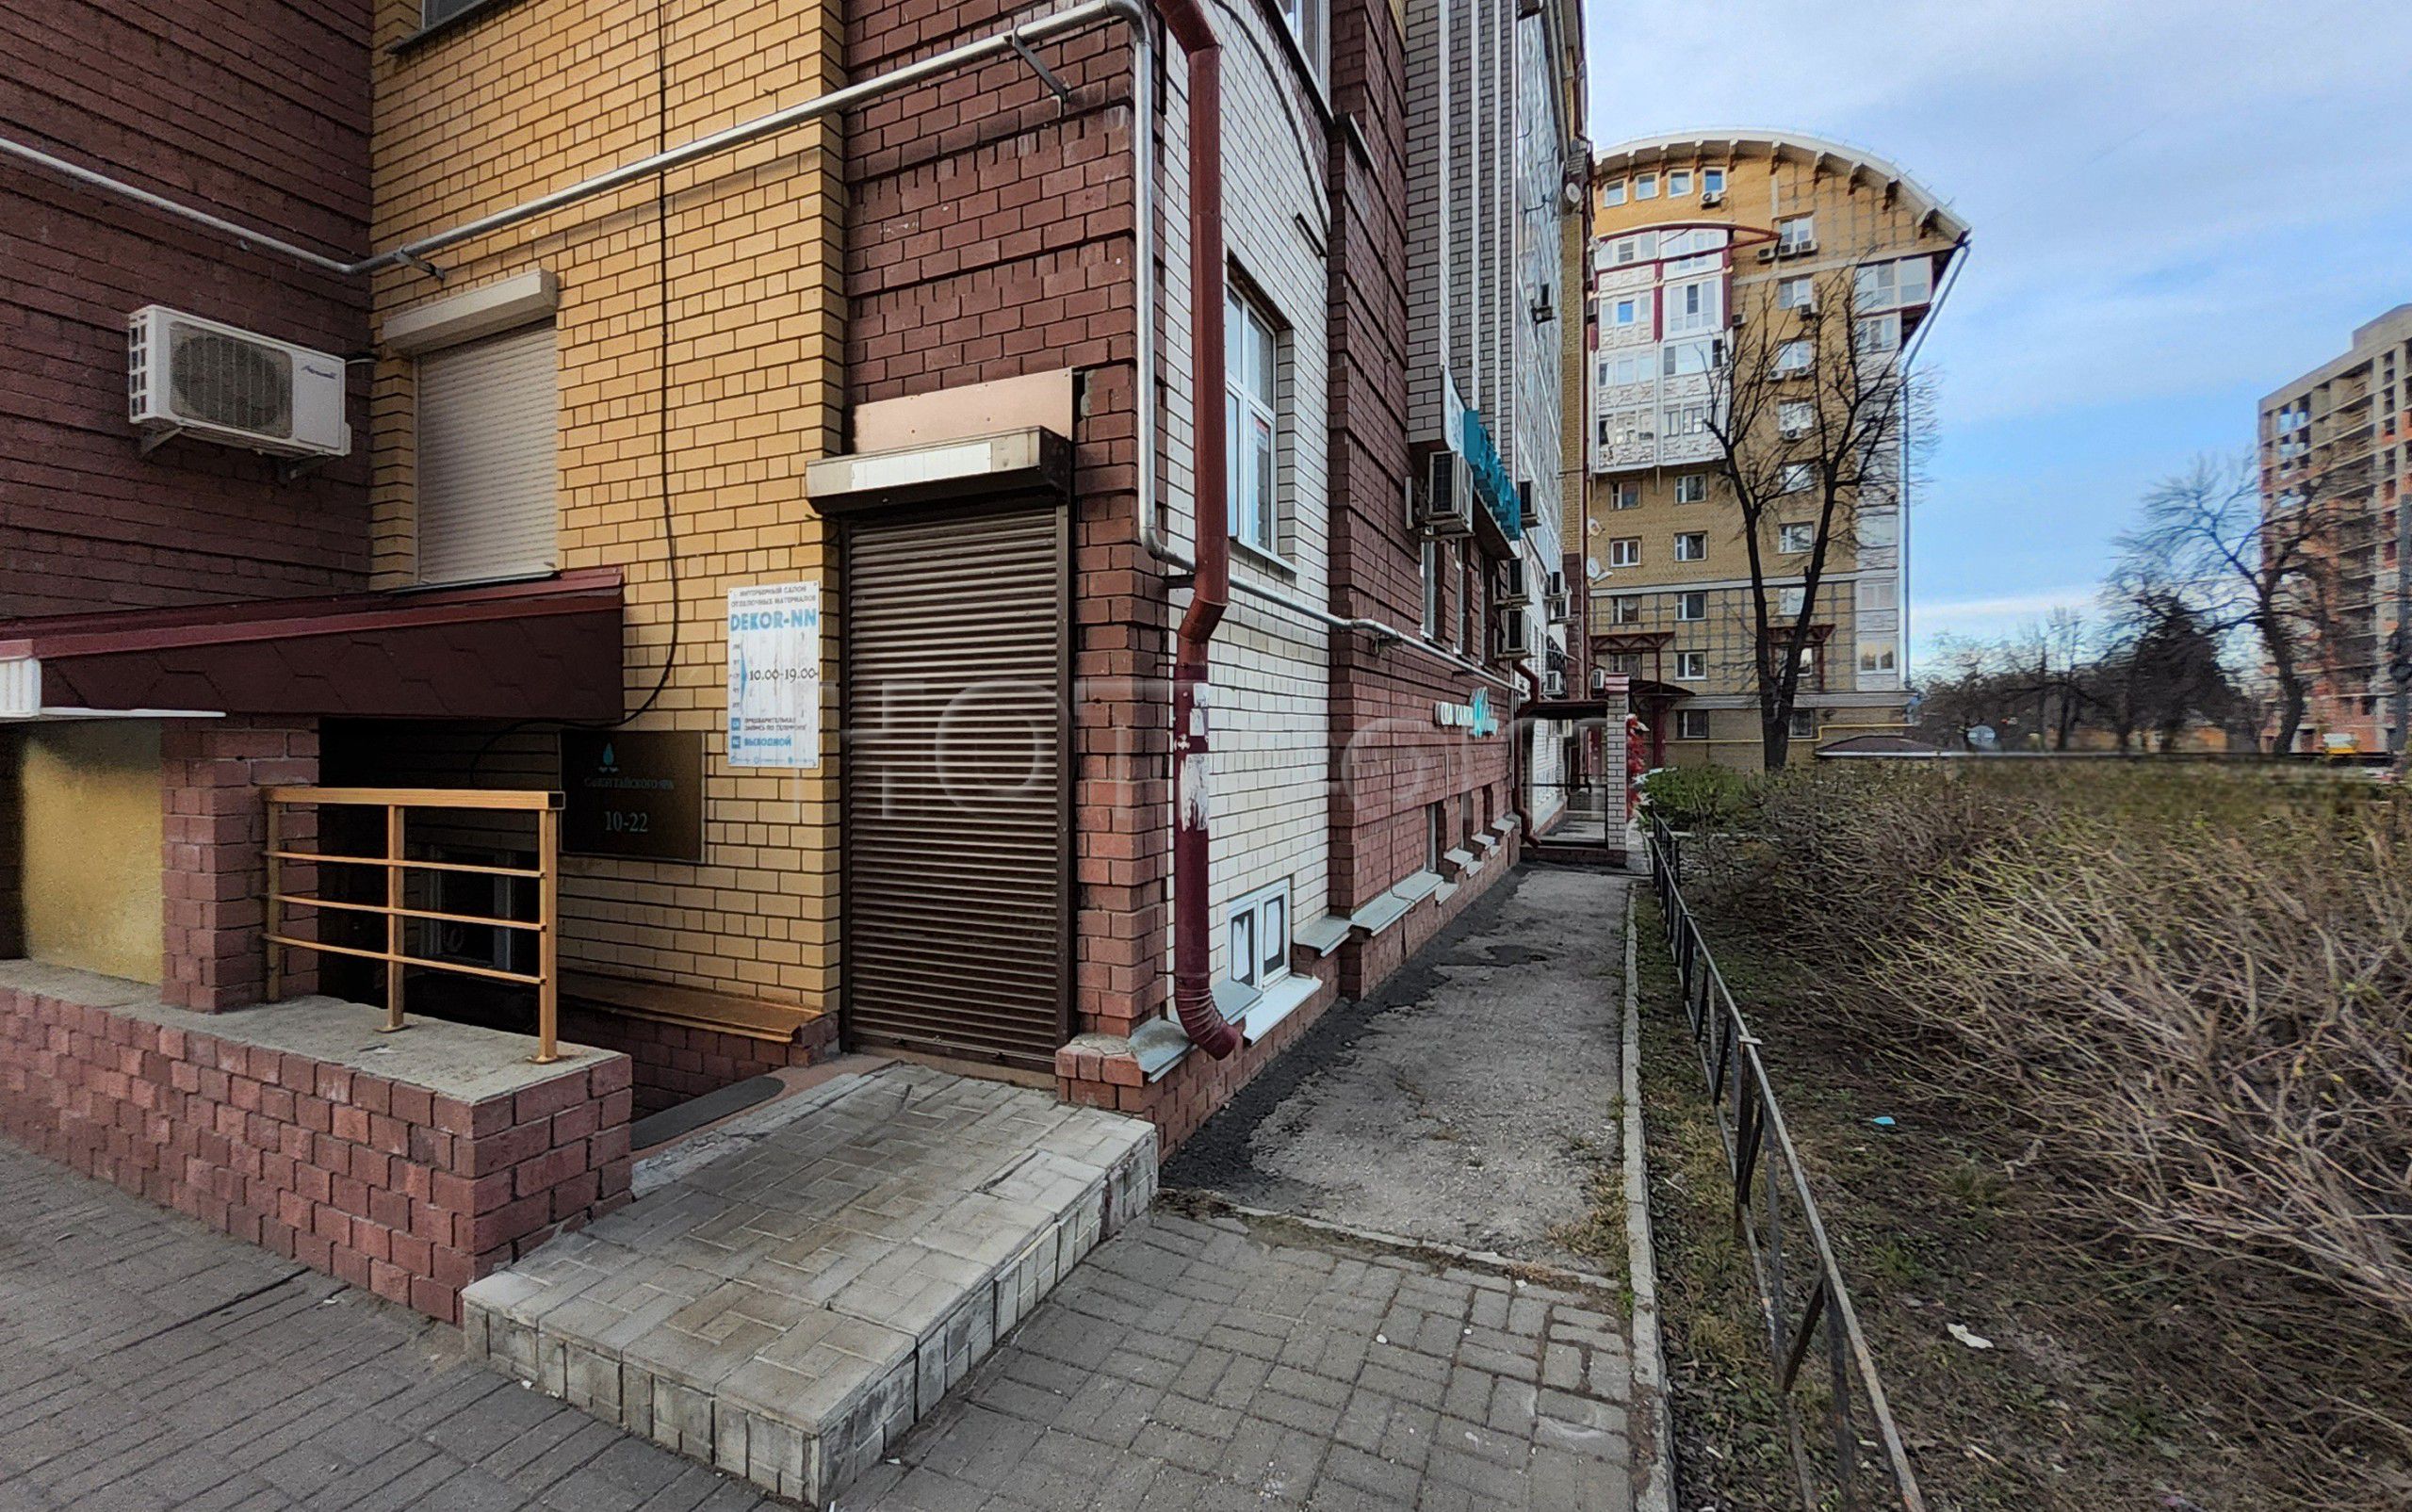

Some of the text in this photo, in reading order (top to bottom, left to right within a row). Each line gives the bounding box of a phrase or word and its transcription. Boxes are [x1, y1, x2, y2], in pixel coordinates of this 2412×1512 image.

[730, 608, 817, 631] DEKOR-NN
[744, 735, 791, 747] ВЫХОДНОЙ
[604, 810, 648, 832] 10-22
